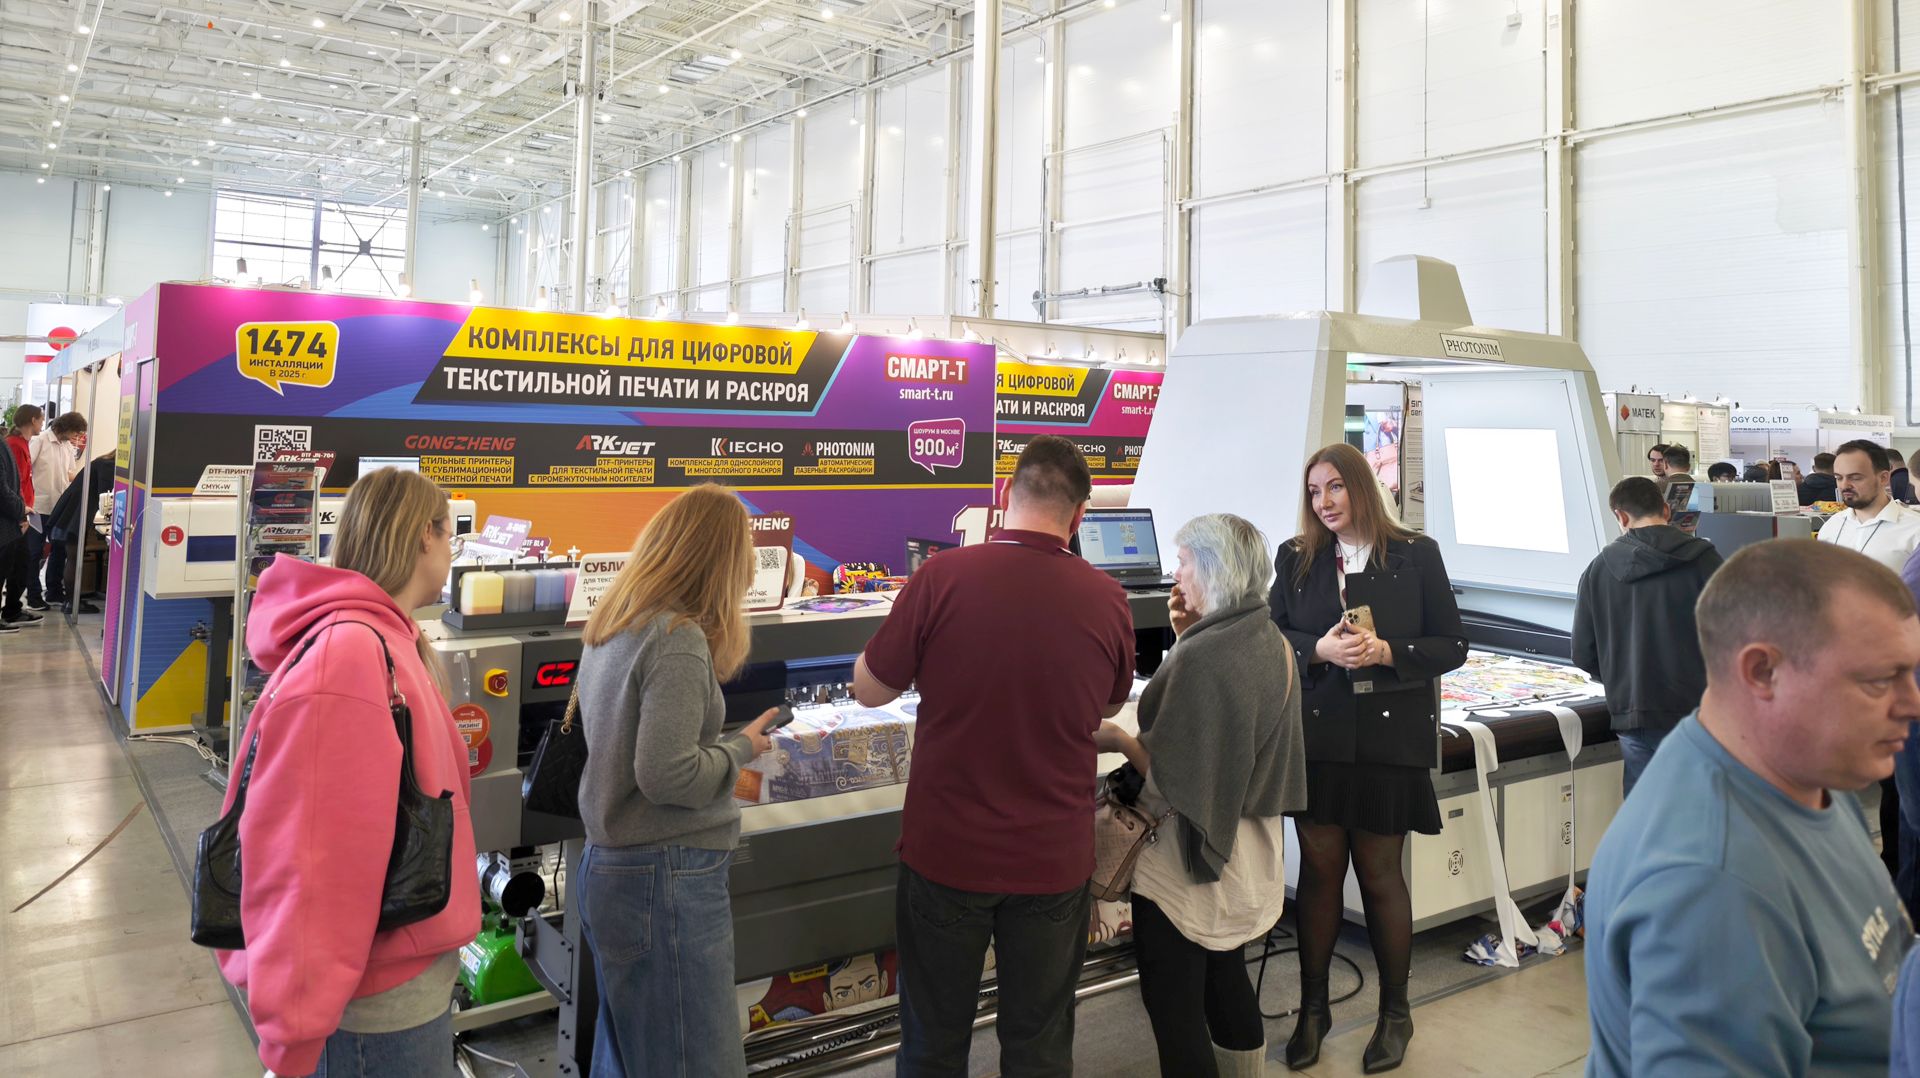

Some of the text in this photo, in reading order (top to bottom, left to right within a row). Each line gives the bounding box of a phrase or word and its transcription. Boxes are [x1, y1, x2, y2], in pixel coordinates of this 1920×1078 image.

[246, 328, 328, 358] 1474
[468, 326, 793, 366] КОМПЛЕКСЫ ДЛЯ ЦИФРОВОЙ
[1445, 339, 1501, 356] PHOTONIM
[249, 359, 324, 370] ИНСТАЛЛЯЦИИ
[887, 356, 966, 381] СМАРТ-Т
[278, 369, 300, 378] 2025
[443, 366, 809, 403] ТЕКСТИЛЬНОЙ ПЕЧАТИ И РАСКРОЯ
[996, 373, 1075, 391] Я ЦИФРОВОЙ
[899, 387, 954, 401] smart-t.ru
[996, 399, 1086, 417] АТИ И РАСКРОЯ
[1631, 408, 1656, 419] MATEK
[1731, 416, 1750, 424] OGY
[1772, 416, 1789, 424] LTD
[404, 434, 517, 451] GONGZHENG
[576, 434, 656, 455] ARK-JET
[914, 438, 945, 456] 900
[997, 440, 1028, 453] RK-JE
[816, 442, 875, 456] PHOTONIM
[1079, 445, 1106, 453] ECHO
[421, 457, 512, 466] СТИЛЬНЫЕ ПРИНТЕРЫ
[597, 458, 653, 466] DTF-ПРИНТЕРЫ
[669, 459, 782, 467] КОМПЛЕКСЫ ДЛЯ ОДНОСЛОЙНОГО
[819, 459, 873, 467] АВТОМАТИЧЕСКИЕ
[272, 464, 305, 473] RK-JET
[432, 466, 512, 475] СУБЛИМАЦИОННОЙ
[551, 467, 569, 475] ДЛЯ
[571, 466, 623, 475] ТЕКСТИЛЬНОЙ
[694, 467, 752, 475] МНОГОСЛОЙНОГО
[427, 475, 512, 483] ИГМЕНТНОЙ ПЕЧАТИ
[537, 475, 608, 483] ПРОМЕЖУТОЧНЫМ
[747, 517, 790, 531] HENG
[955, 507, 989, 547] 1
[584, 561, 625, 573] СУБЛИ
[587, 595, 601, 608] 16
